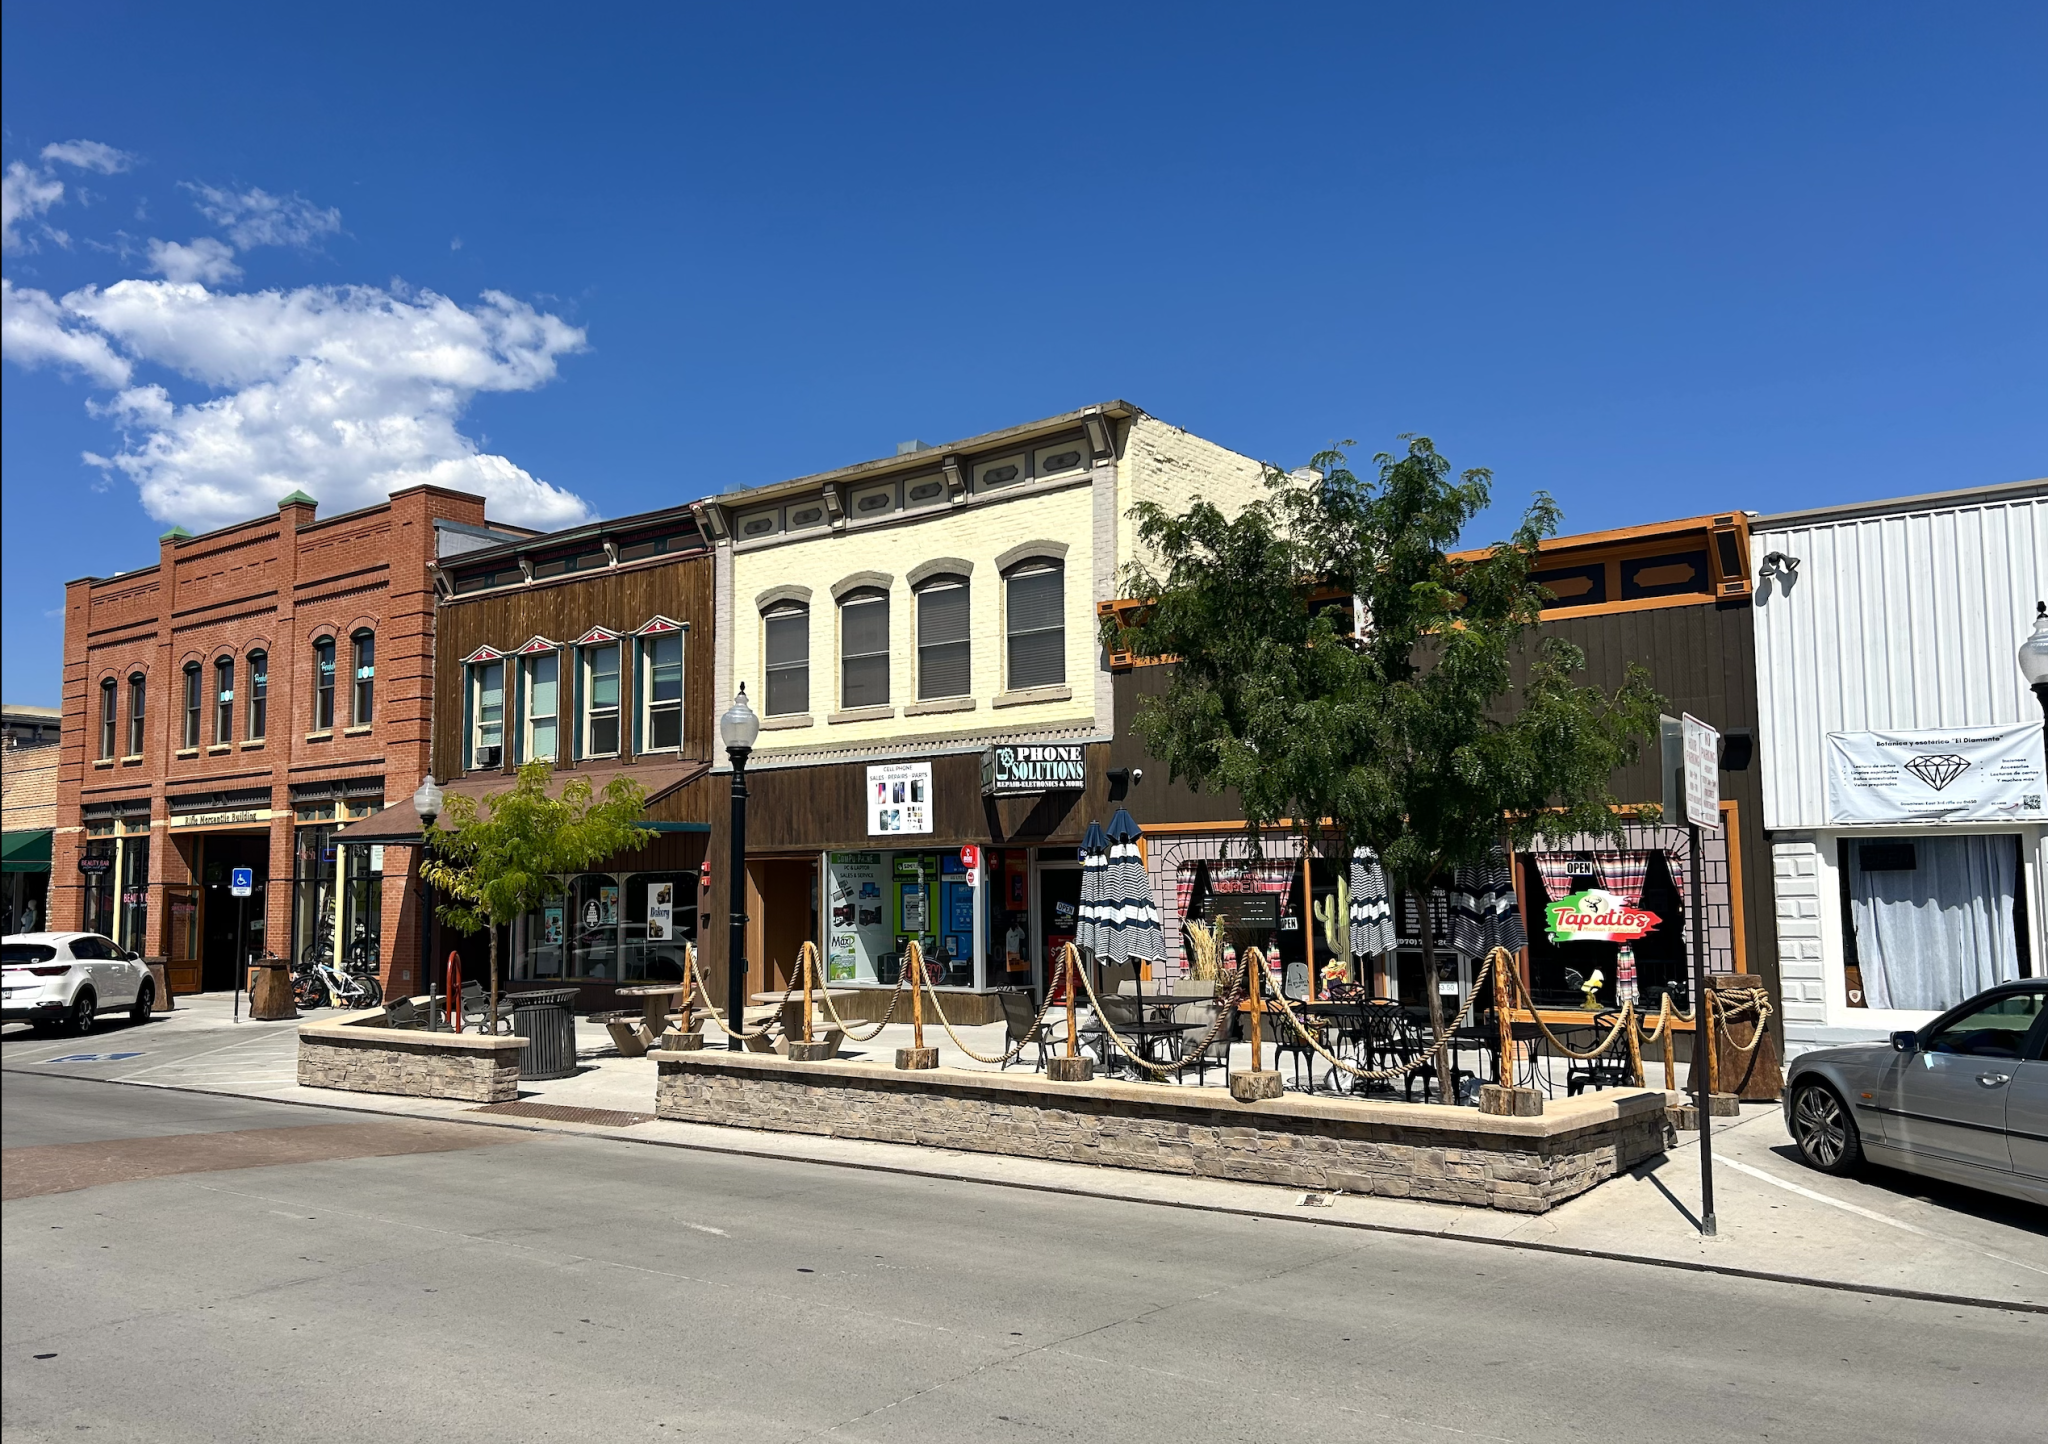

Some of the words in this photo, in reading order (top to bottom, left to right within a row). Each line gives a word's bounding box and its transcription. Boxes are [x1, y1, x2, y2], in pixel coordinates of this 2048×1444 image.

[1016, 746, 1082, 761] PHONE
[1011, 761, 1084, 780] SOLUTIONS
[1065, 780, 1084, 788] MORE
[184, 815, 198, 825] Rifle
[199, 811, 230, 825] Mercantile
[231, 810, 257, 822] Building
[81, 859, 99, 867] BEAUTY
[100, 859, 110, 867] BAR
[1567, 862, 1591, 874] OPEN
[1219, 879, 1262, 893] OPEN
[650, 907, 670, 920] Bakery
[1058, 902, 1073, 913] OPEN
[1553, 907, 1648, 932] Tapatios
